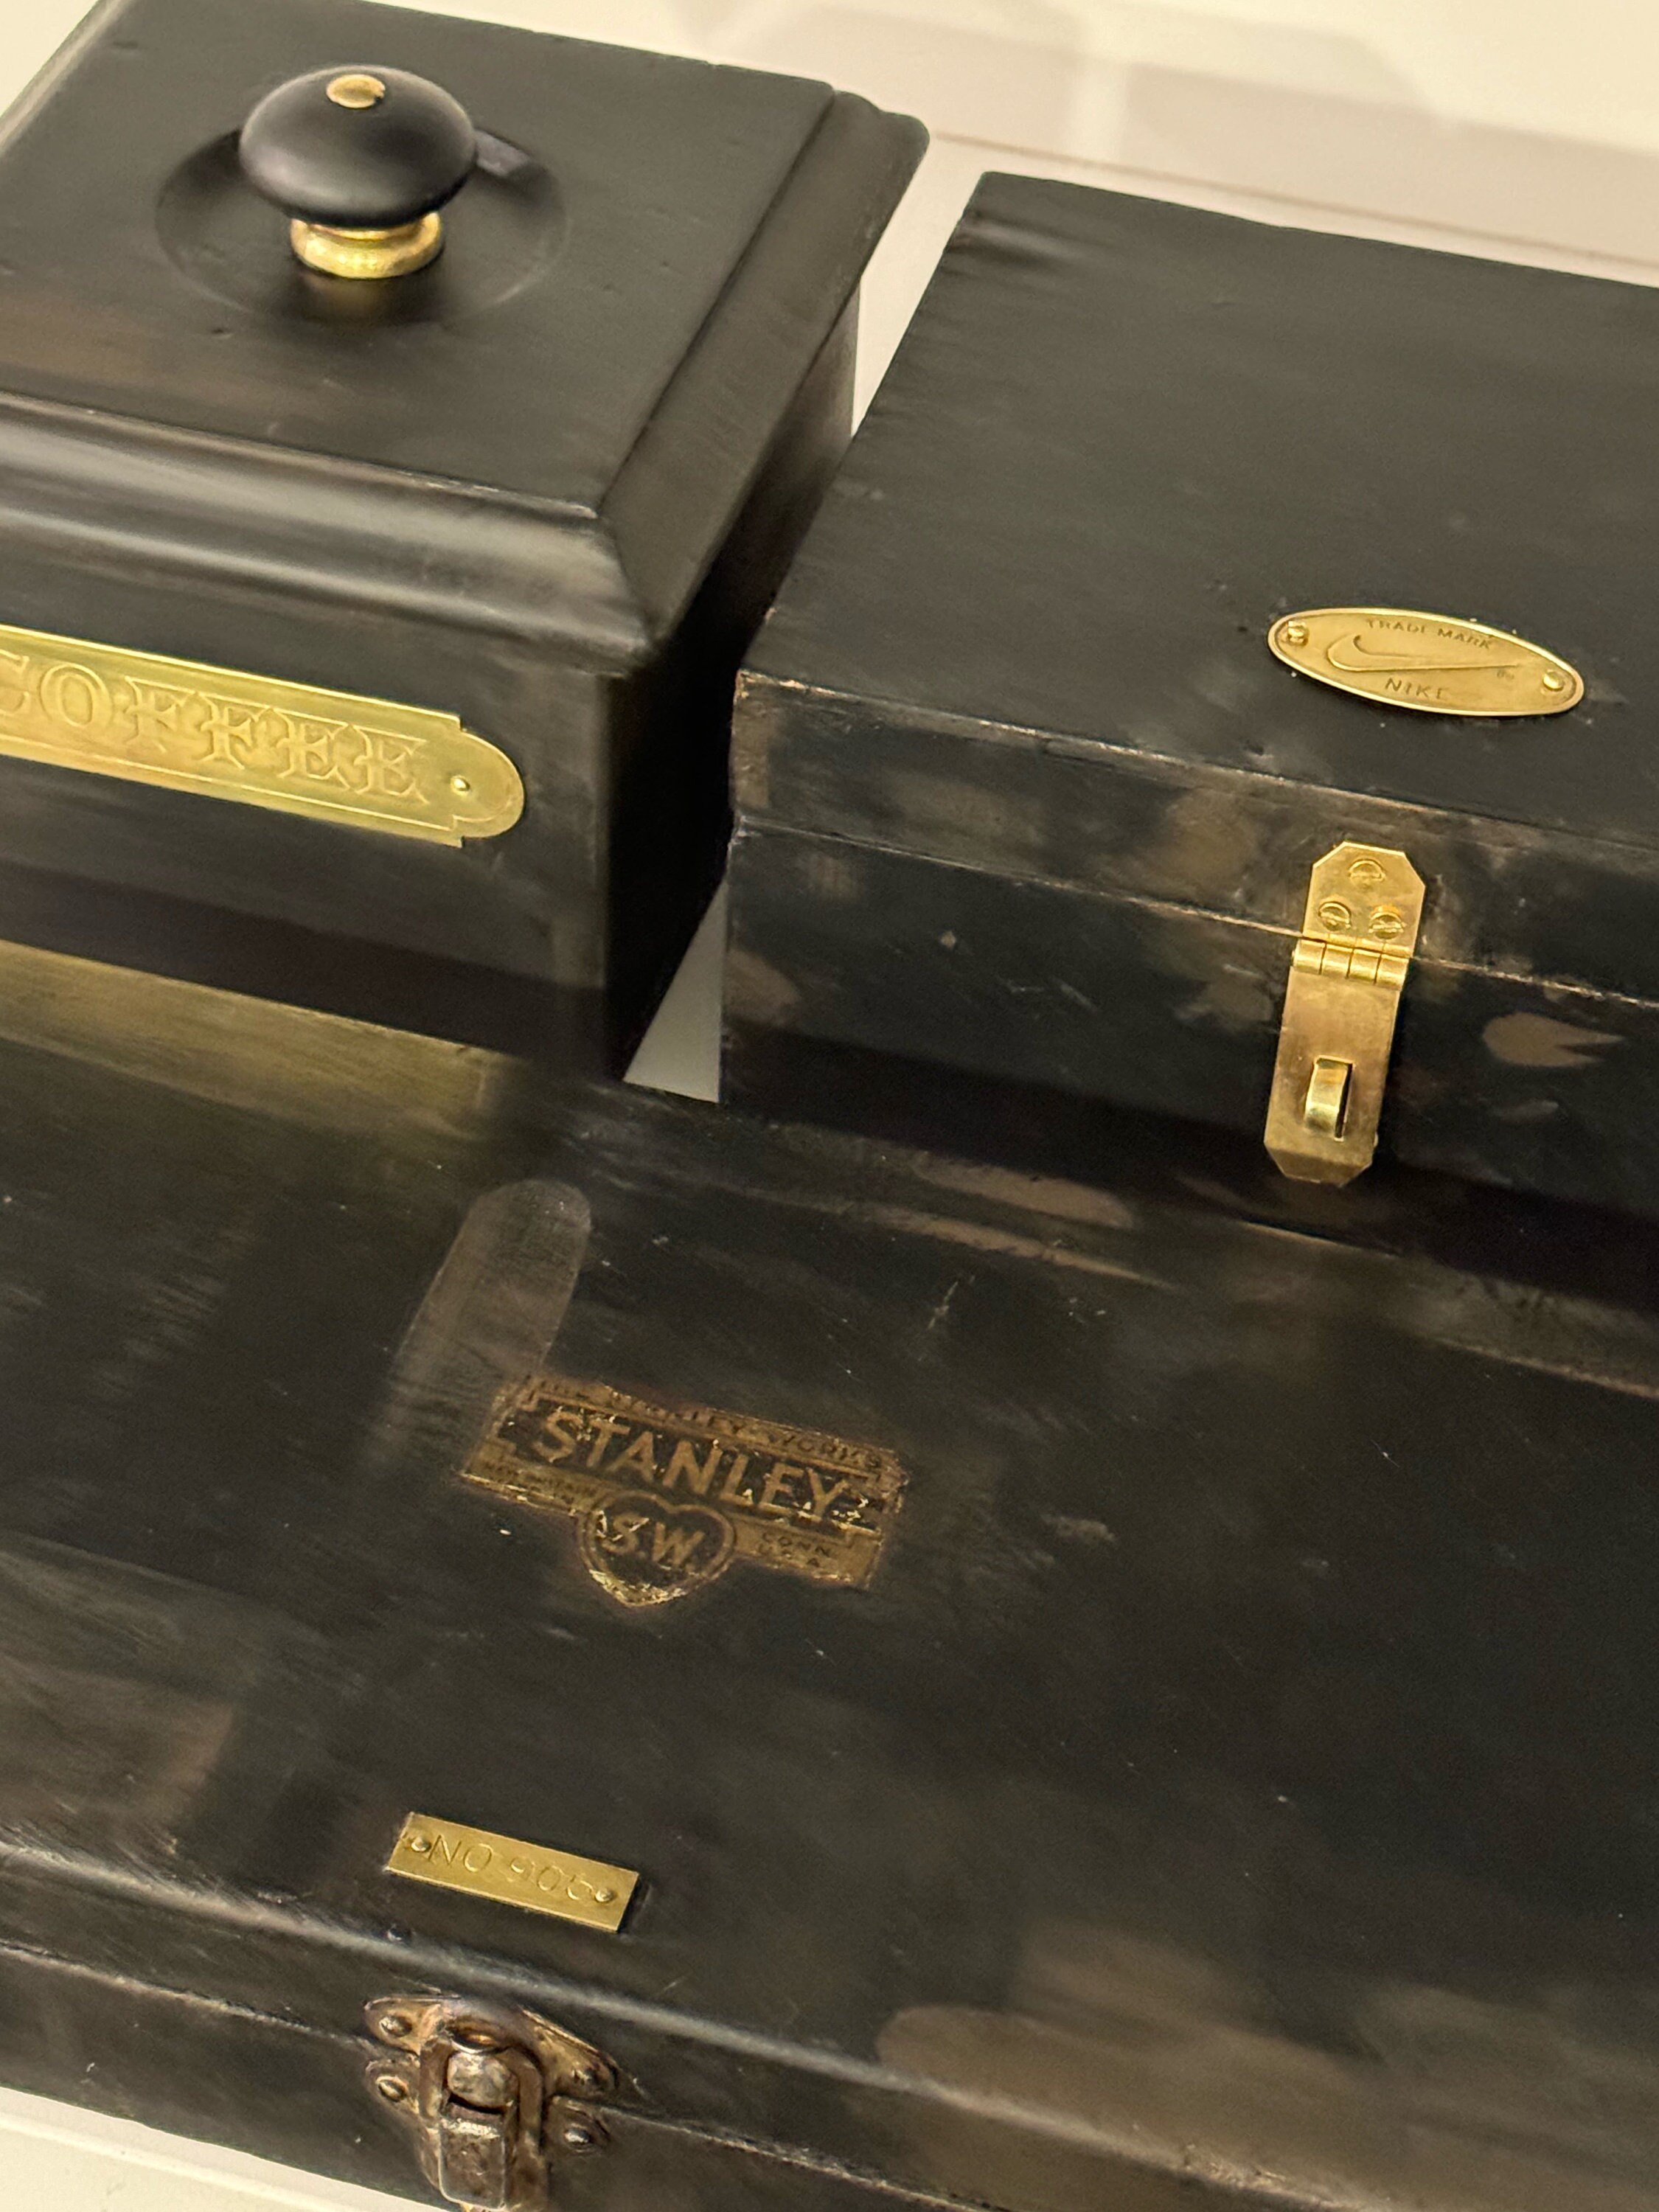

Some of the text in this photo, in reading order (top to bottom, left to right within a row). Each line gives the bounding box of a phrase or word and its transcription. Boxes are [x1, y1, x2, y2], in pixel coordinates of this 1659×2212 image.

[1384, 677, 1451, 700] NIKE
[531, 1408, 849, 1523] STANLEY
[427, 1834, 494, 1873] NO
